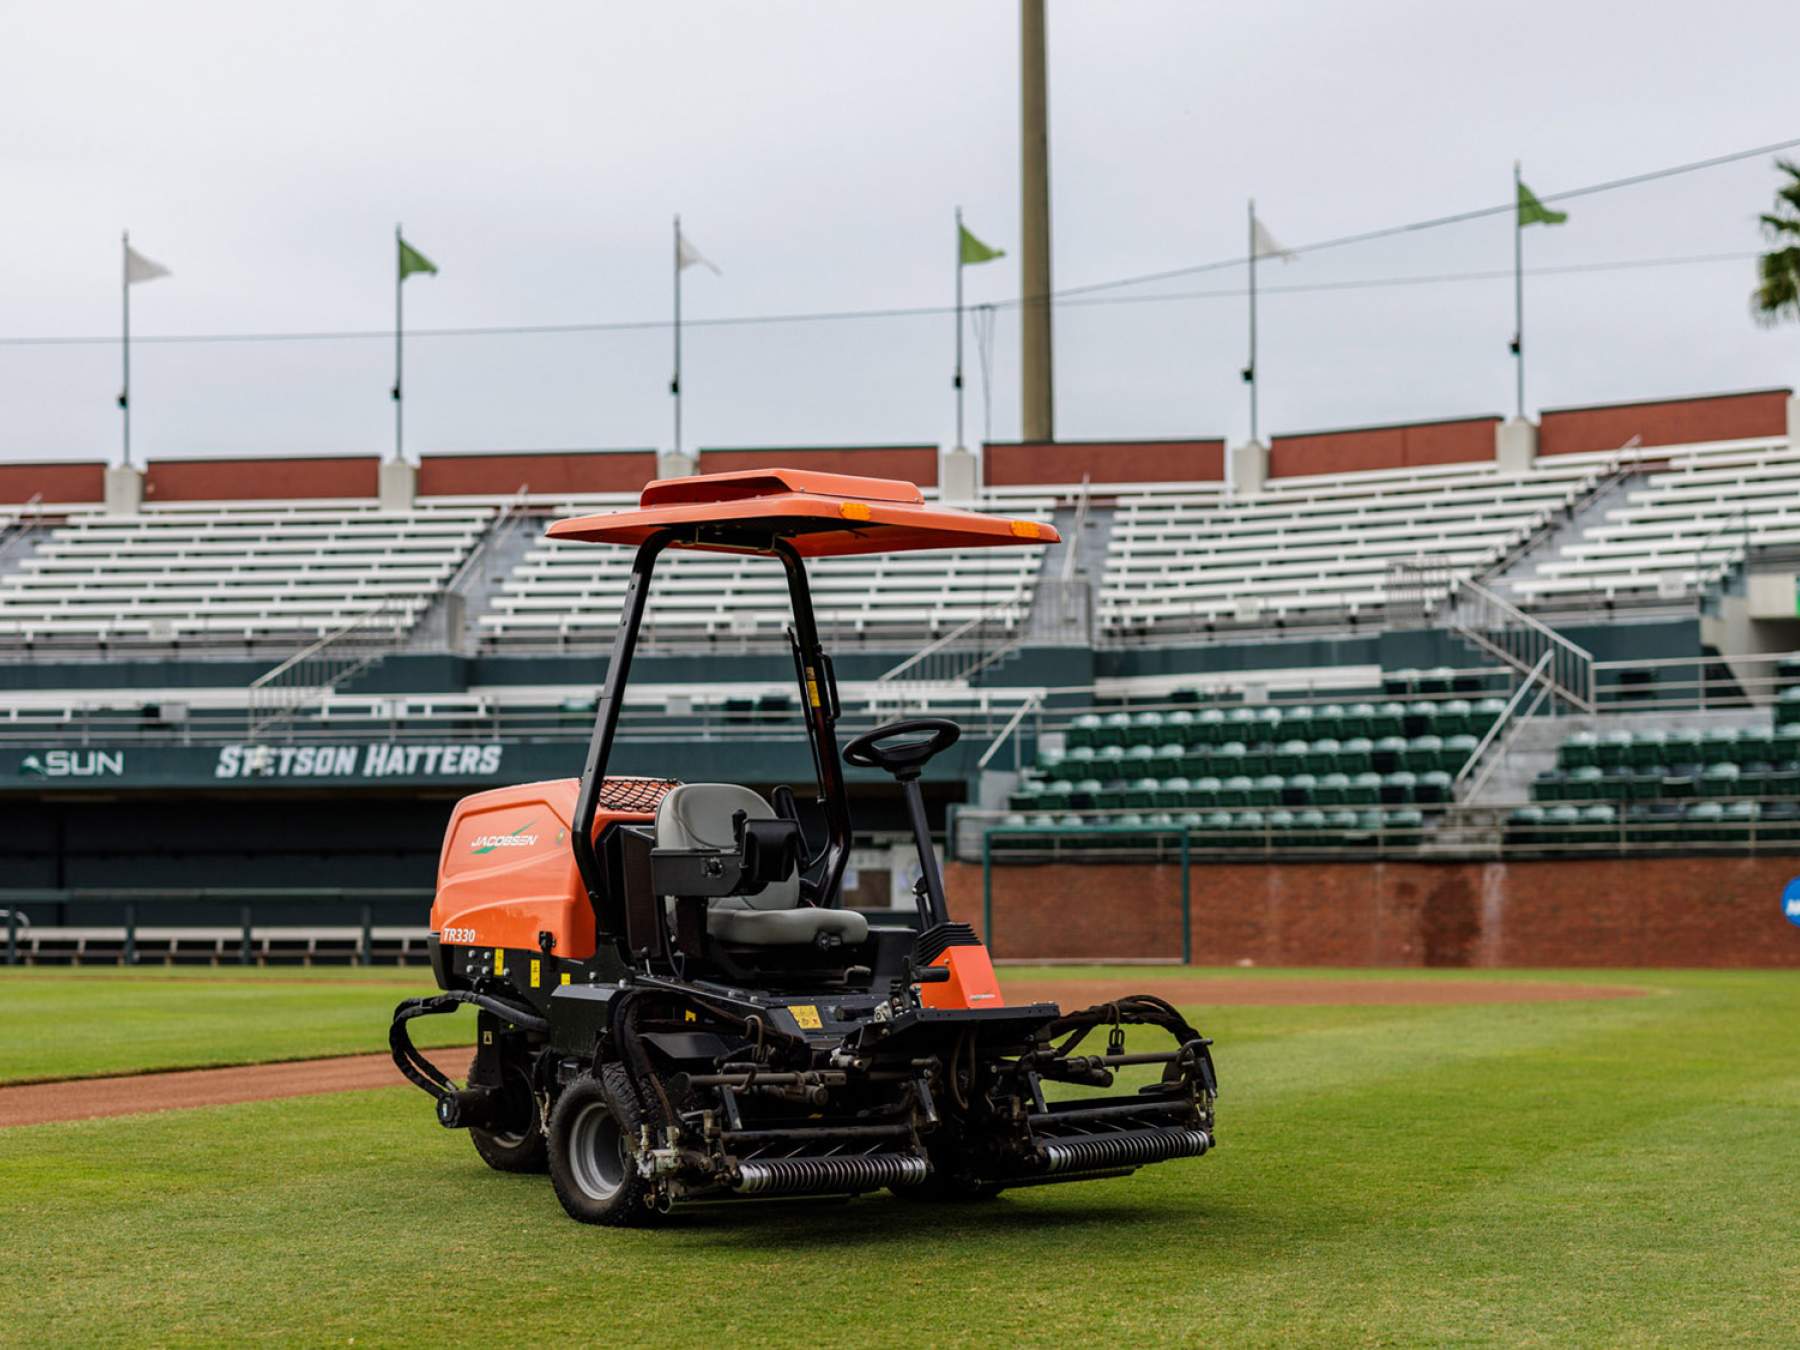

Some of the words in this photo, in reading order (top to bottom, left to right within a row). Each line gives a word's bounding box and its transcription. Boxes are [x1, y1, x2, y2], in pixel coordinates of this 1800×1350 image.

[46, 750, 123, 776] SUN
[363, 743, 503, 777] HATTERS
[470, 834, 539, 847] JACOBSEN
[443, 927, 476, 943] TR330
